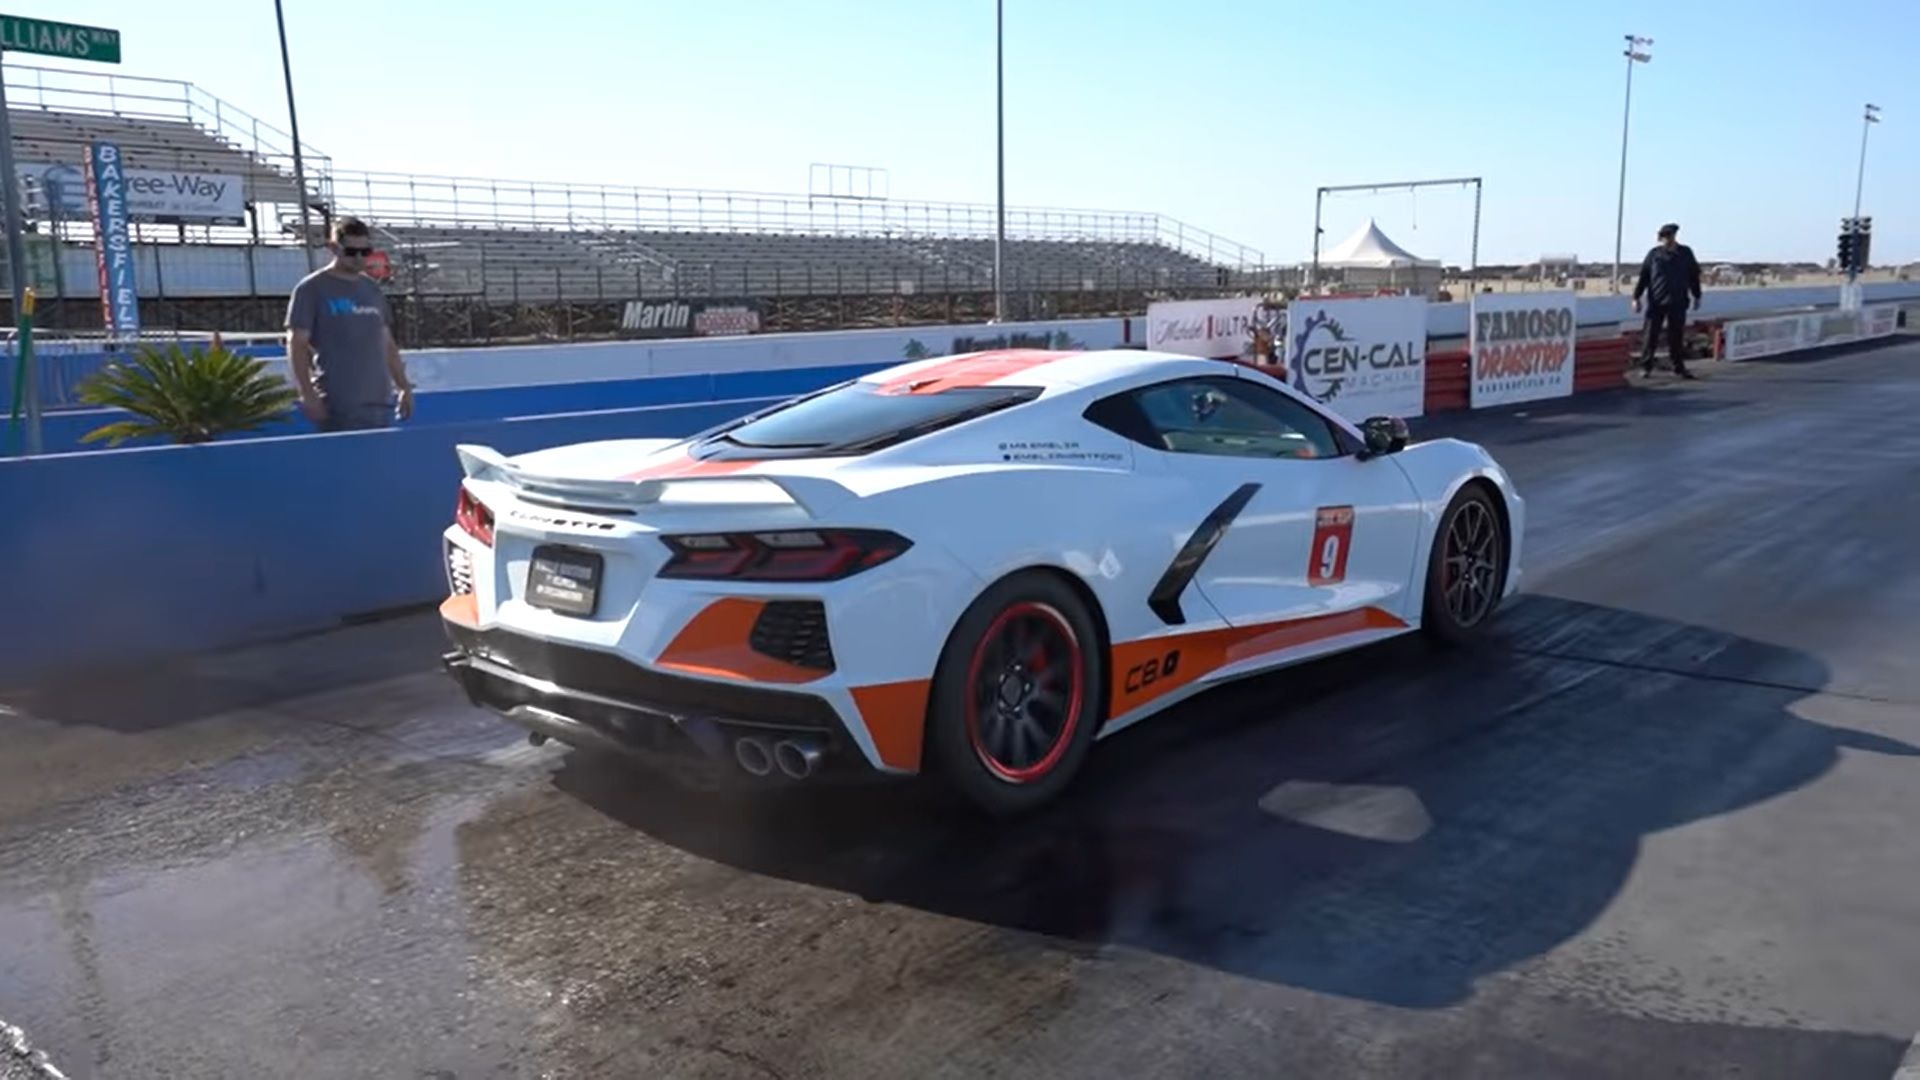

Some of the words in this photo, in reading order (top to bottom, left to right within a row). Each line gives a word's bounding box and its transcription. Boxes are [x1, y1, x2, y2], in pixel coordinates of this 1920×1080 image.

[91, 30, 117, 44] WAY
[622, 301, 690, 329] Martin
[1476, 307, 1572, 342] FAMOSO
[1477, 341, 1568, 381] DRAGSTRIP
[1321, 535, 1340, 578] 9
